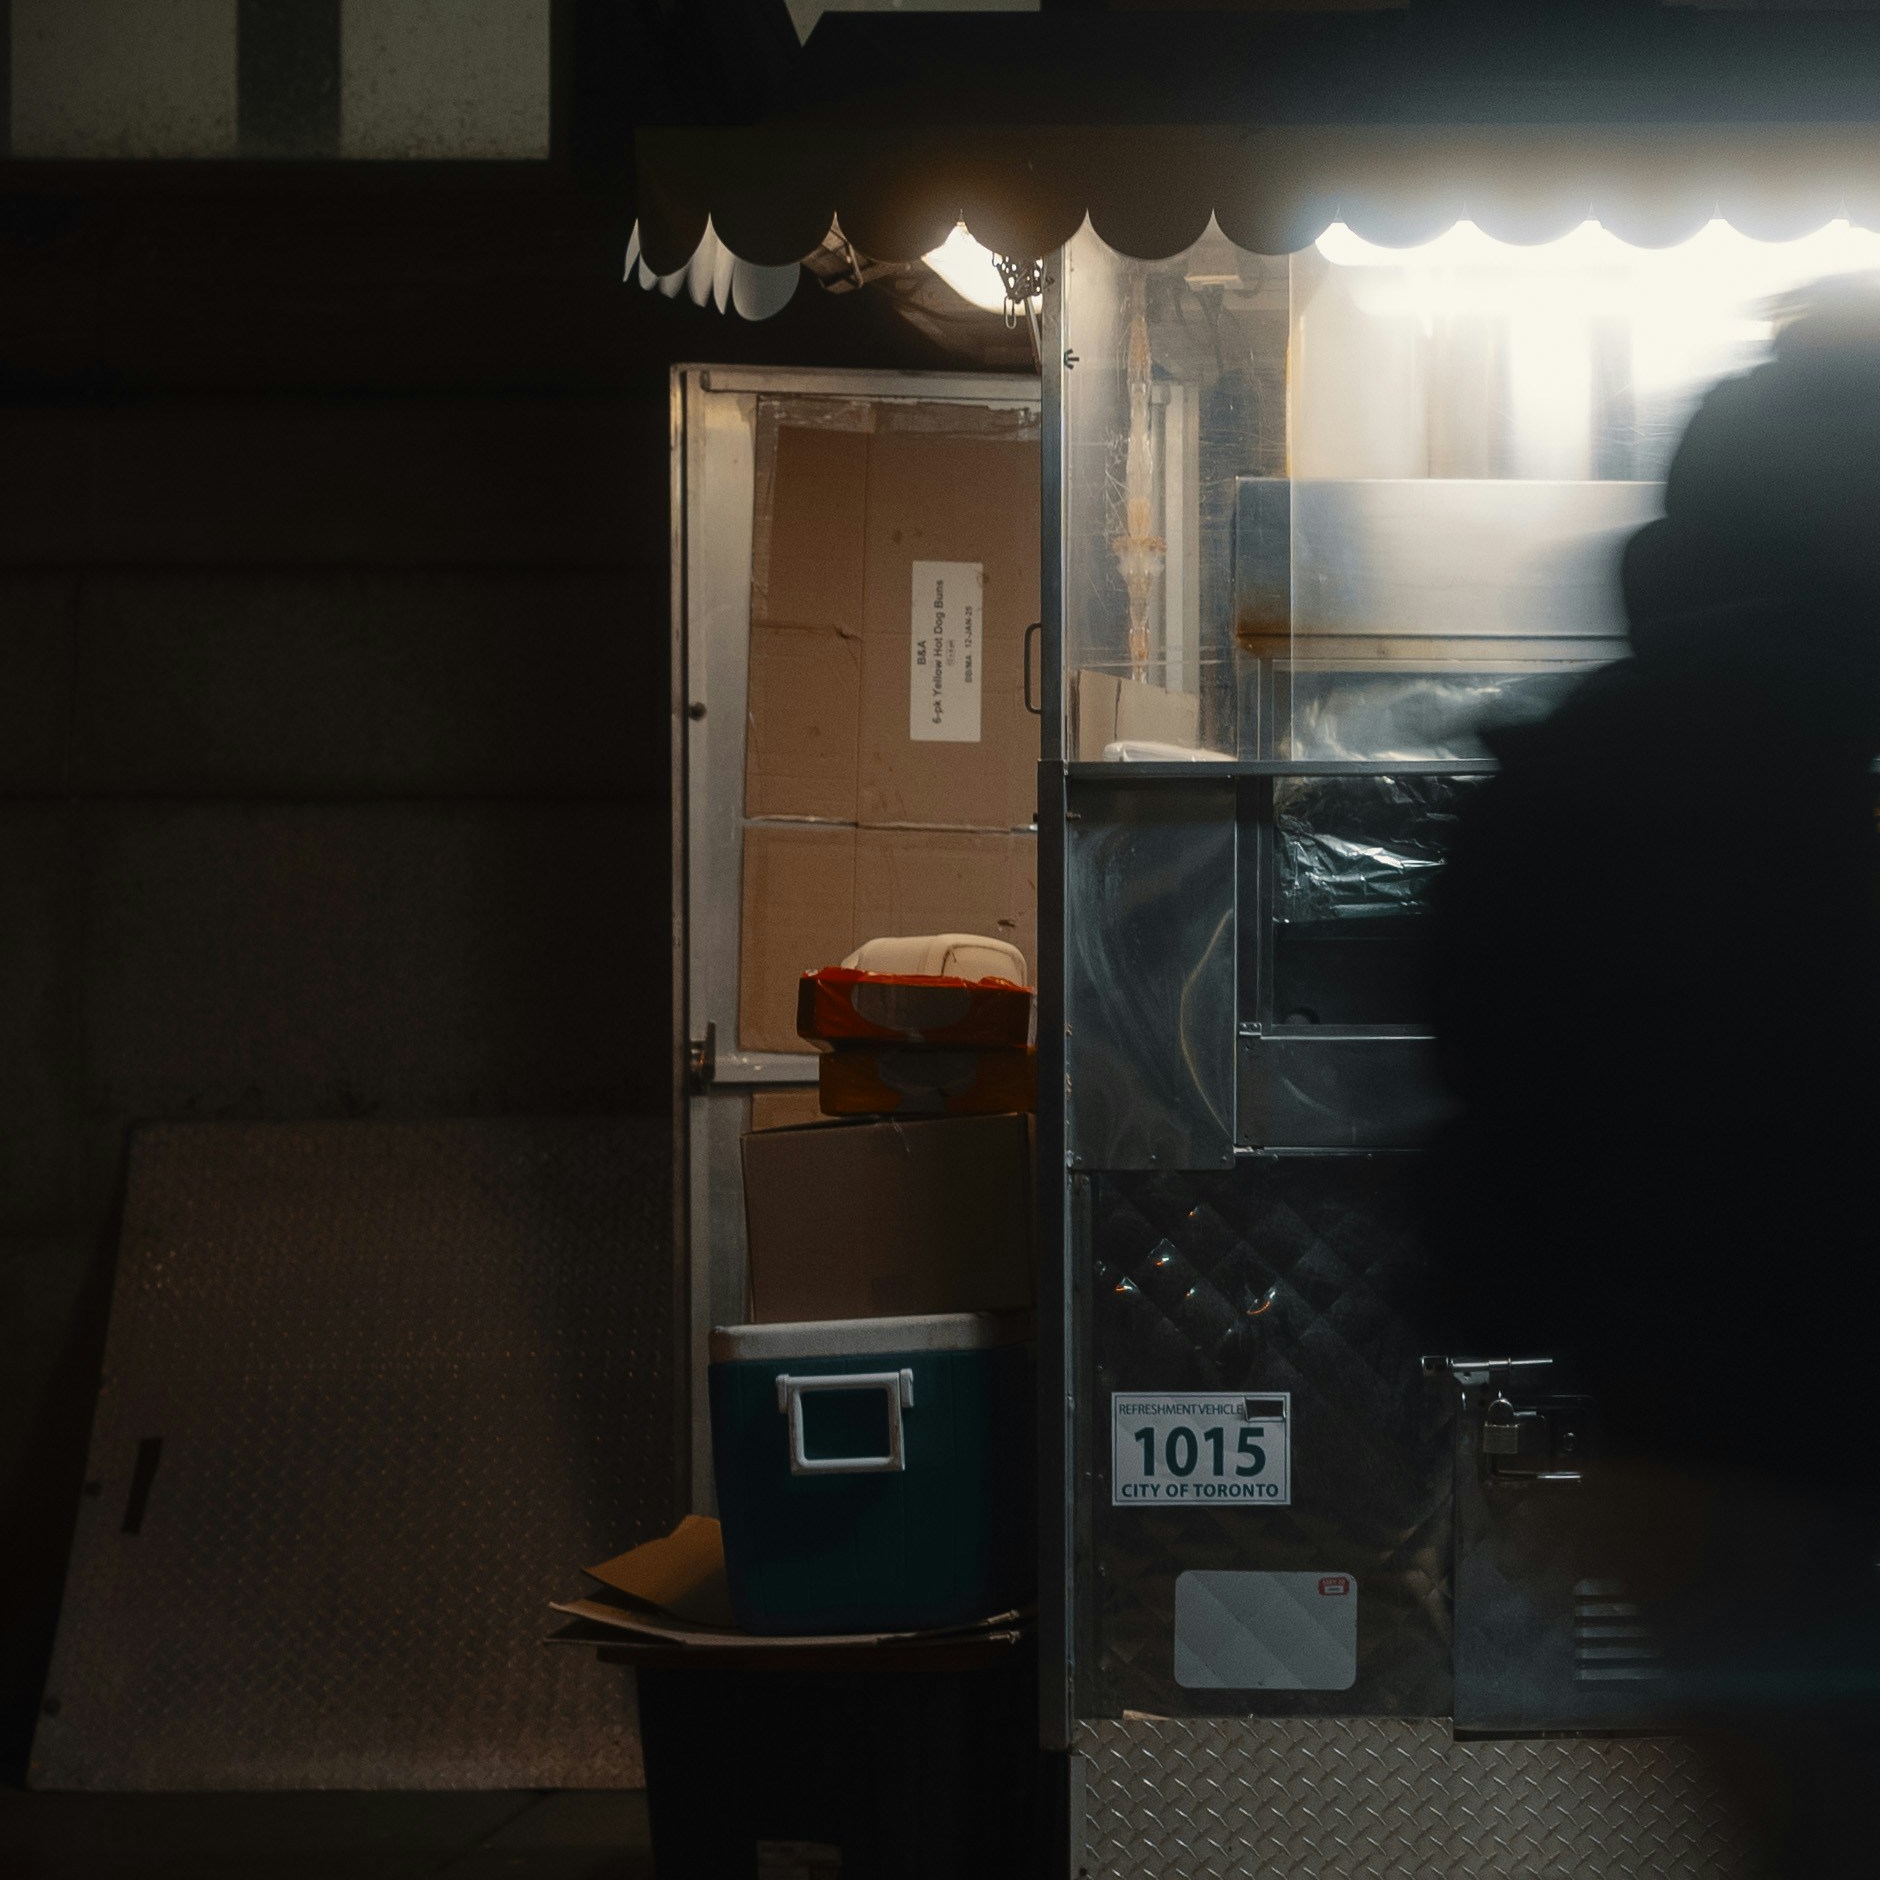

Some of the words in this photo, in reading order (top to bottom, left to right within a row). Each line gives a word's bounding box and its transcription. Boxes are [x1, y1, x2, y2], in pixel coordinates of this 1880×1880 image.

[934, 579, 944, 609] Buns
[934, 611, 946, 635] Dog
[916, 640, 926, 666] B&A
[933, 637, 943, 657] Hot
[932, 660, 943, 698] Yellow
[931, 699, 944, 725] 6-pk
[1119, 1403, 1197, 1415] REFRESHMENT
[1199, 1403, 1243, 1415] VEHICLE
[1134, 1426, 1267, 1478] 1015
[1121, 1483, 1161, 1498] CITY
[1165, 1483, 1189, 1498] OF
[1193, 1483, 1279, 1498] TORONTO
